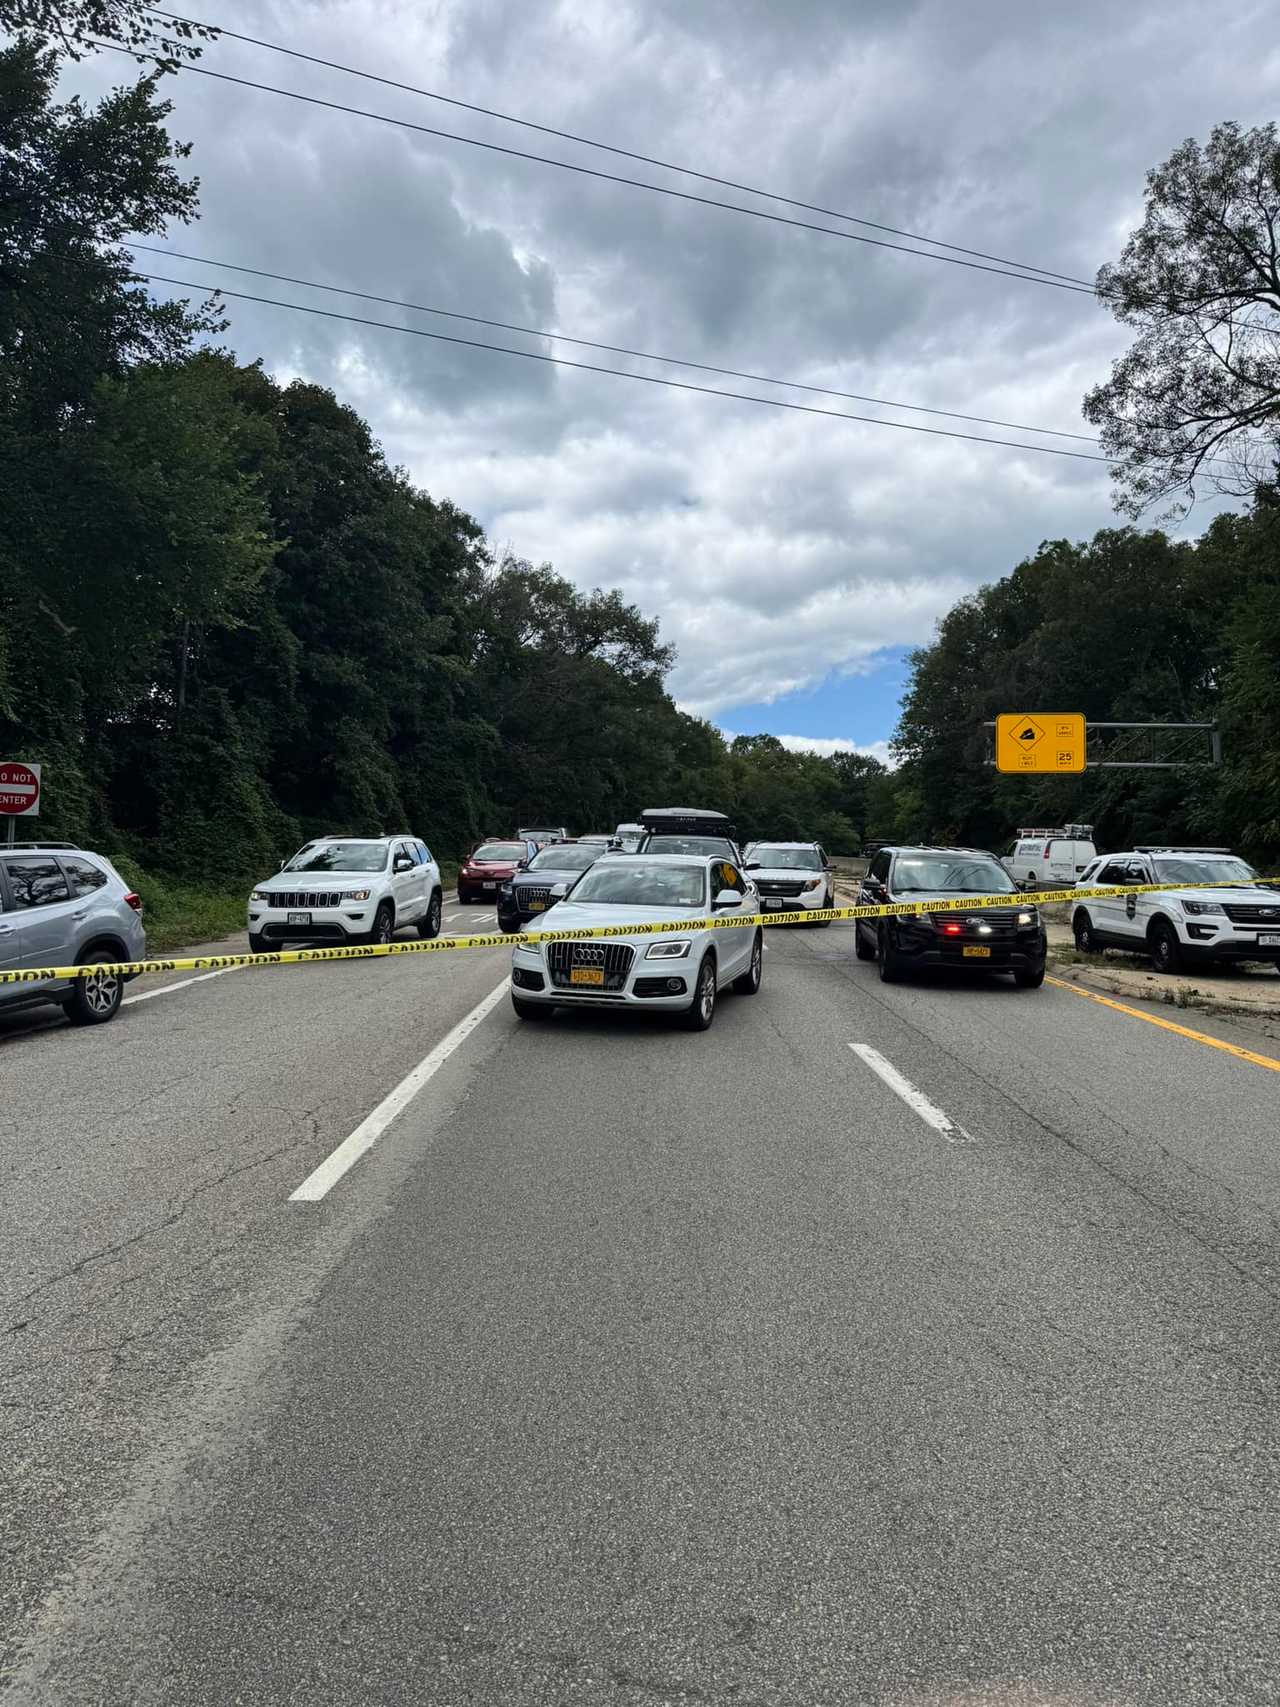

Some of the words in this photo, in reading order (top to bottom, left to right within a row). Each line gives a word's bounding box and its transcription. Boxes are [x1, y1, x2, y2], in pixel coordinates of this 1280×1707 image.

[1059, 752, 1072, 761] 25
[0, 772, 8, 781] O
[12, 773, 32, 783] NOT
[0, 969, 56, 983] TION
[77, 961, 176, 977] CAUTION
[194, 954, 281, 968] CAUTION
[297, 947, 374, 960] CAUTION
[388, 940, 456, 953] CAUTION
[468, 934, 529, 947] CAUTION
[539, 929, 594, 941] CAUTION
[603, 924, 653, 937] CAUTION
[661, 920, 707, 932] CAUTION
[713, 917, 755, 928] CAUTION
[762, 913, 800, 924] CAUTION
[806, 909, 842, 921] CAUTION
[847, 906, 881, 917] CAUTION
[886, 903, 917, 914] CAUTION
[921, 900, 951, 911] CAUTION
[954, 898, 982, 908] CAUTION
[986, 895, 1012, 905] CAUTION
[1015, 893, 1040, 903] CAUTION
[1043, 891, 1067, 901] CAUTION
[1070, 889, 1093, 898] CAUTION
[1094, 888, 1117, 897] CAUTION
